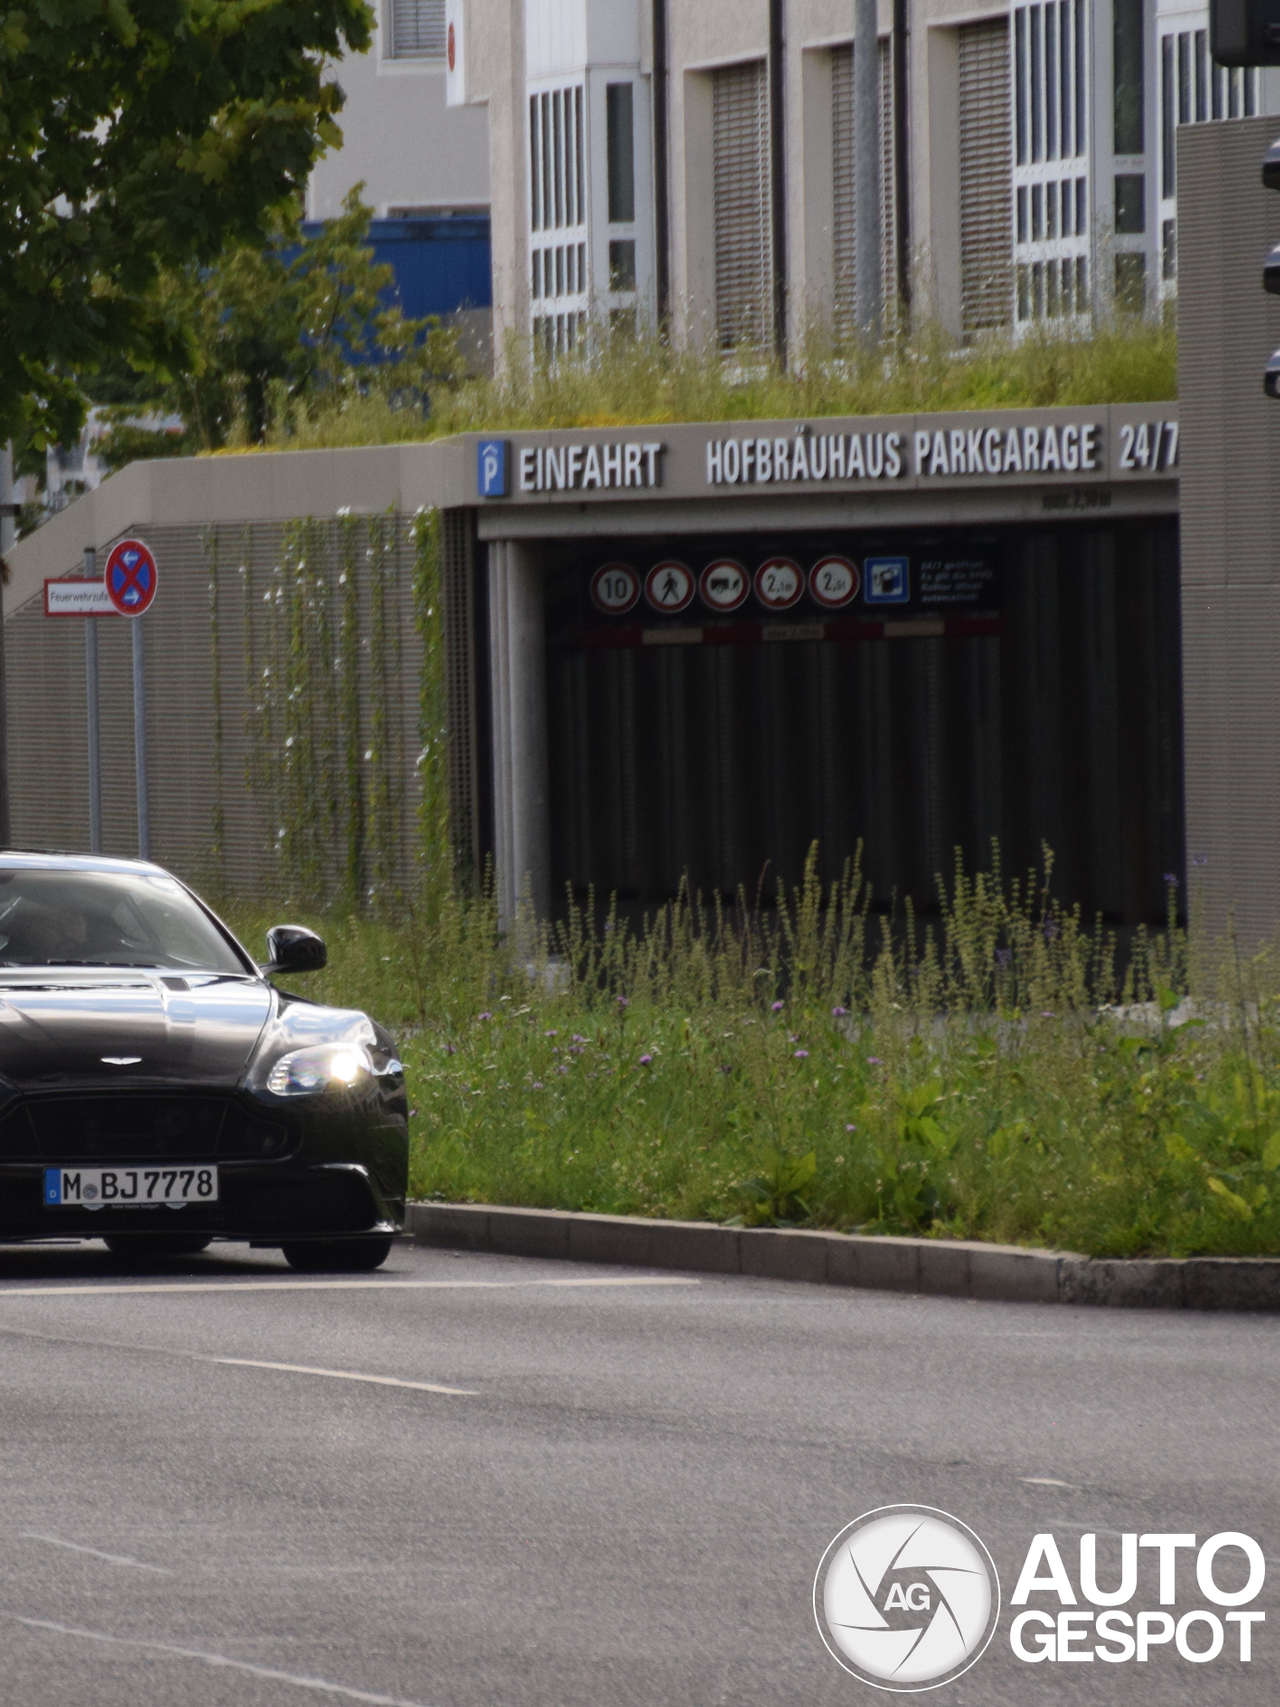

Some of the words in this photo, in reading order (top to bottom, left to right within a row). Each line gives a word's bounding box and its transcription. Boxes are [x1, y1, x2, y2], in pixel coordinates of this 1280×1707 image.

[520, 442, 661, 491] EINFAHRT
[706, 424, 901, 484] HOFBRÄUHAUS
[914, 423, 1096, 476] PARKGARAGE
[1120, 420, 1179, 472] 24/7
[604, 577, 628, 599] 10
[49, 1189, 57, 1198] D
[63, 1172, 81, 1200] M
